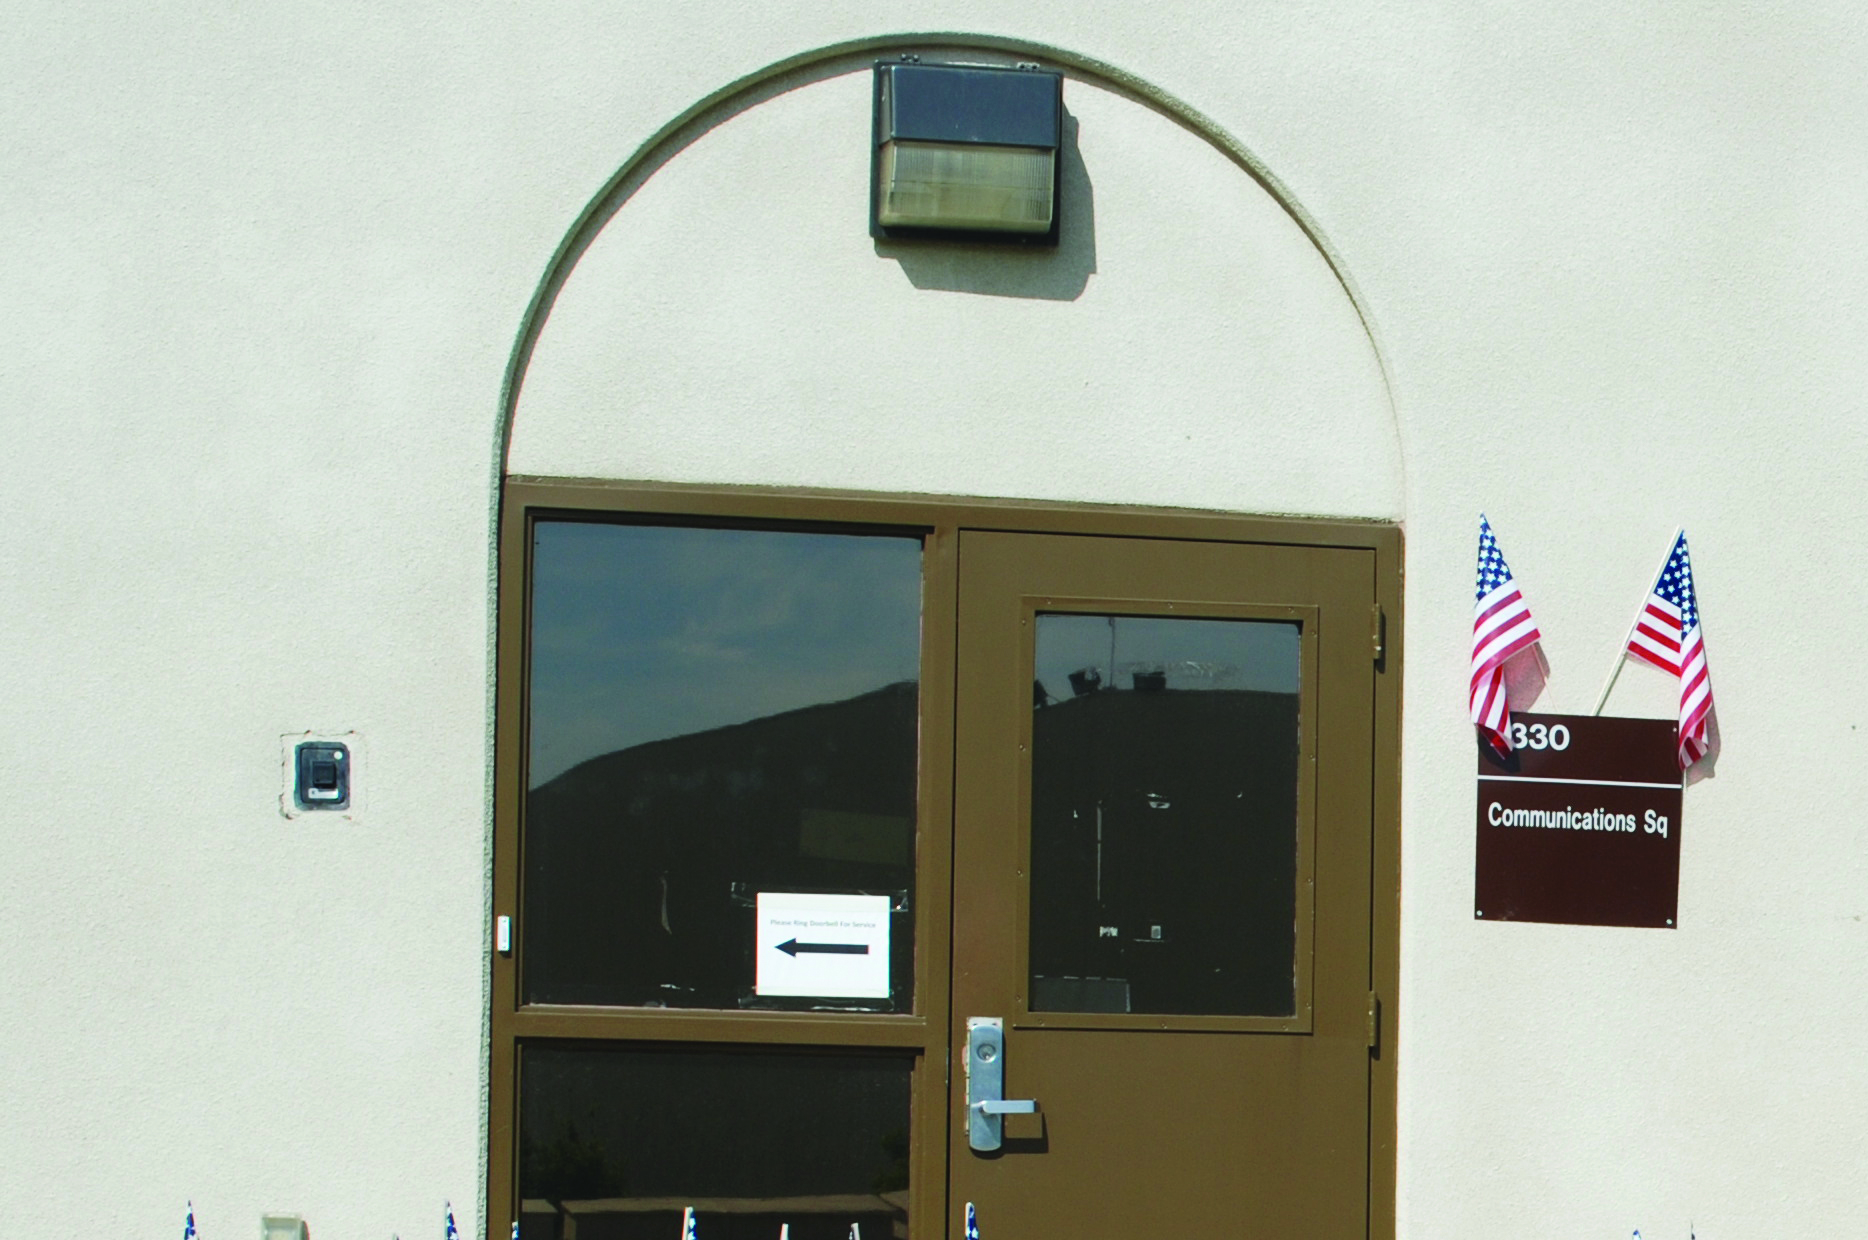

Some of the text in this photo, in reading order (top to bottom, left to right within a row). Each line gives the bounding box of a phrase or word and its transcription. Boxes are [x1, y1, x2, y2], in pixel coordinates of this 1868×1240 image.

[1490, 722, 1570, 751] 330
[1488, 801, 1668, 839] Communications Sq
